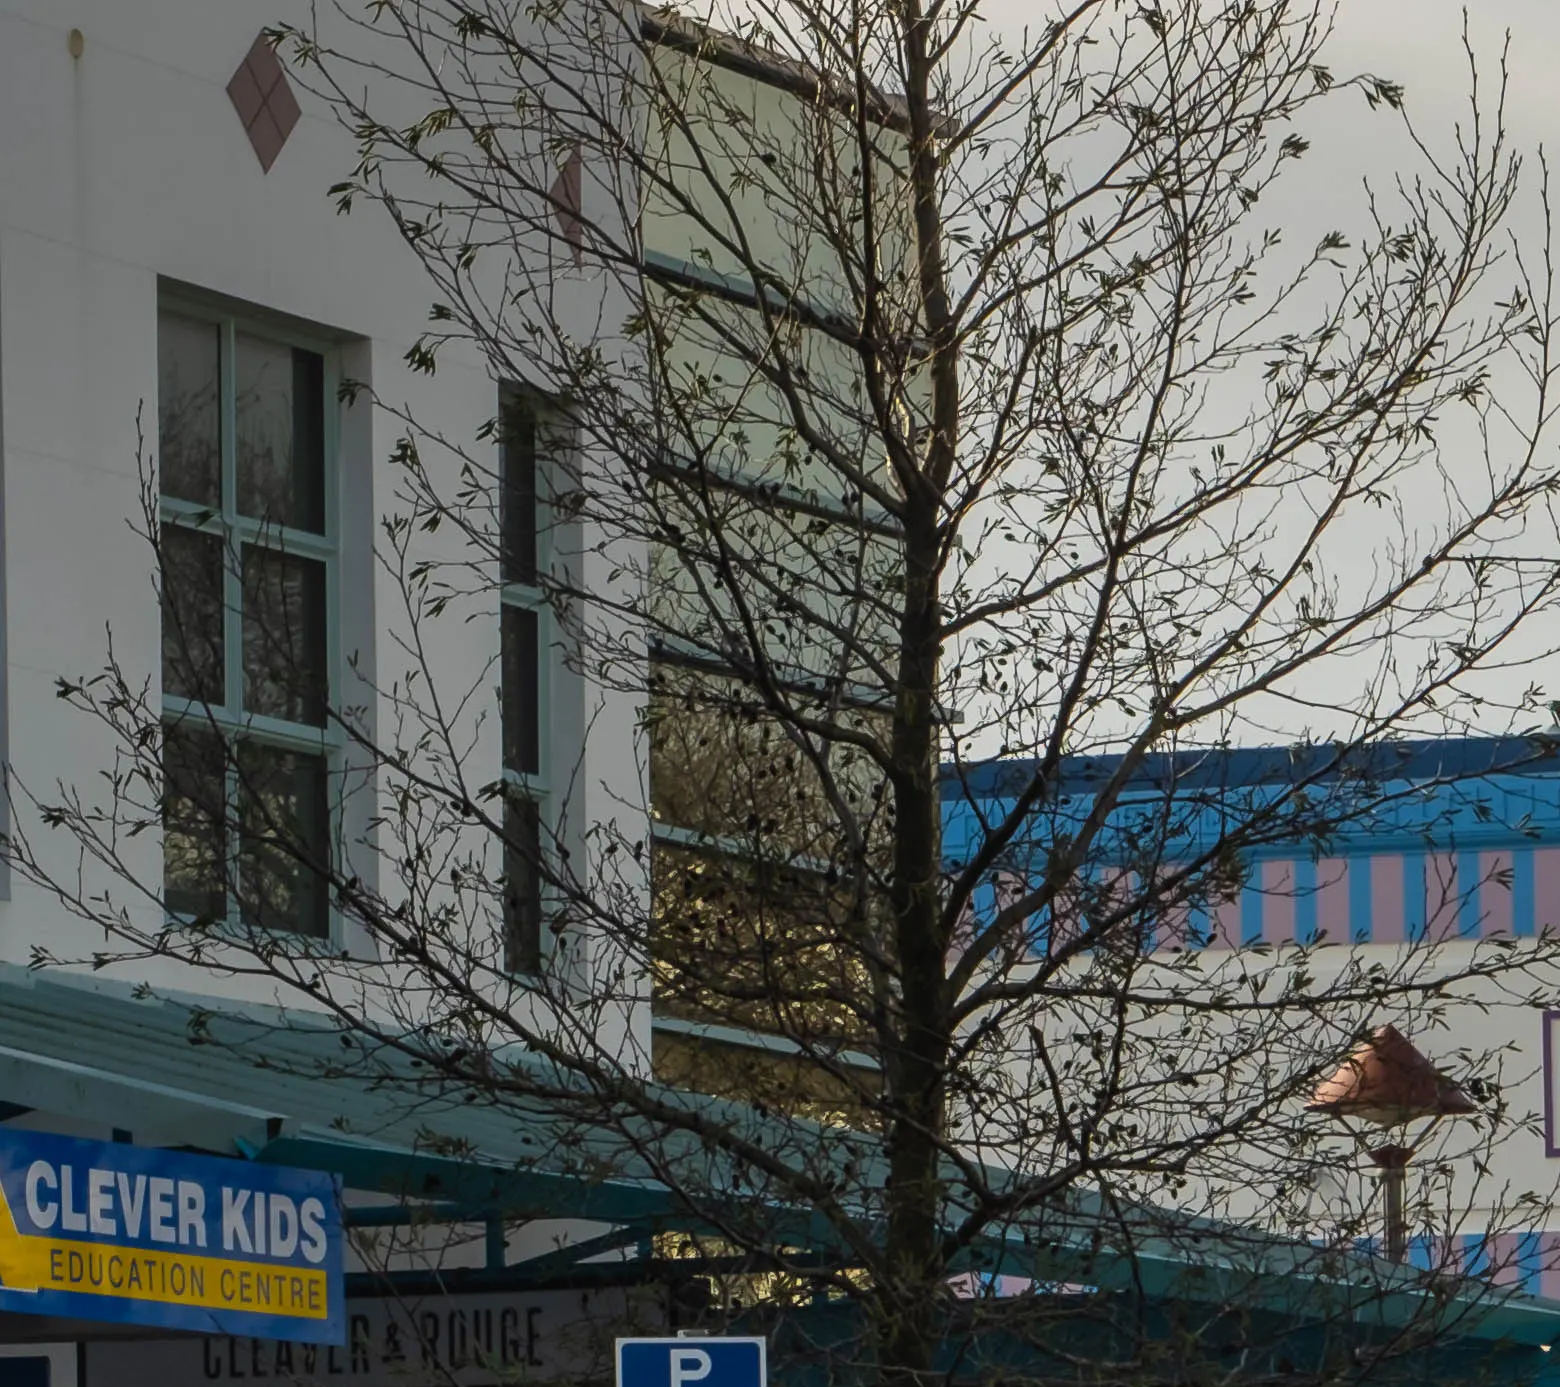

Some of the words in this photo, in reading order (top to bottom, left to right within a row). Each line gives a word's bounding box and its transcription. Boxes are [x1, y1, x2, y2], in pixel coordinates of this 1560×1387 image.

[25, 1159, 208, 1248] CLEVER
[221, 1186, 328, 1264] KIDS
[50, 1249, 205, 1297] EDUCATION
[220, 1268, 321, 1311] CENTRE
[420, 1306, 545, 1370] ROUGE
